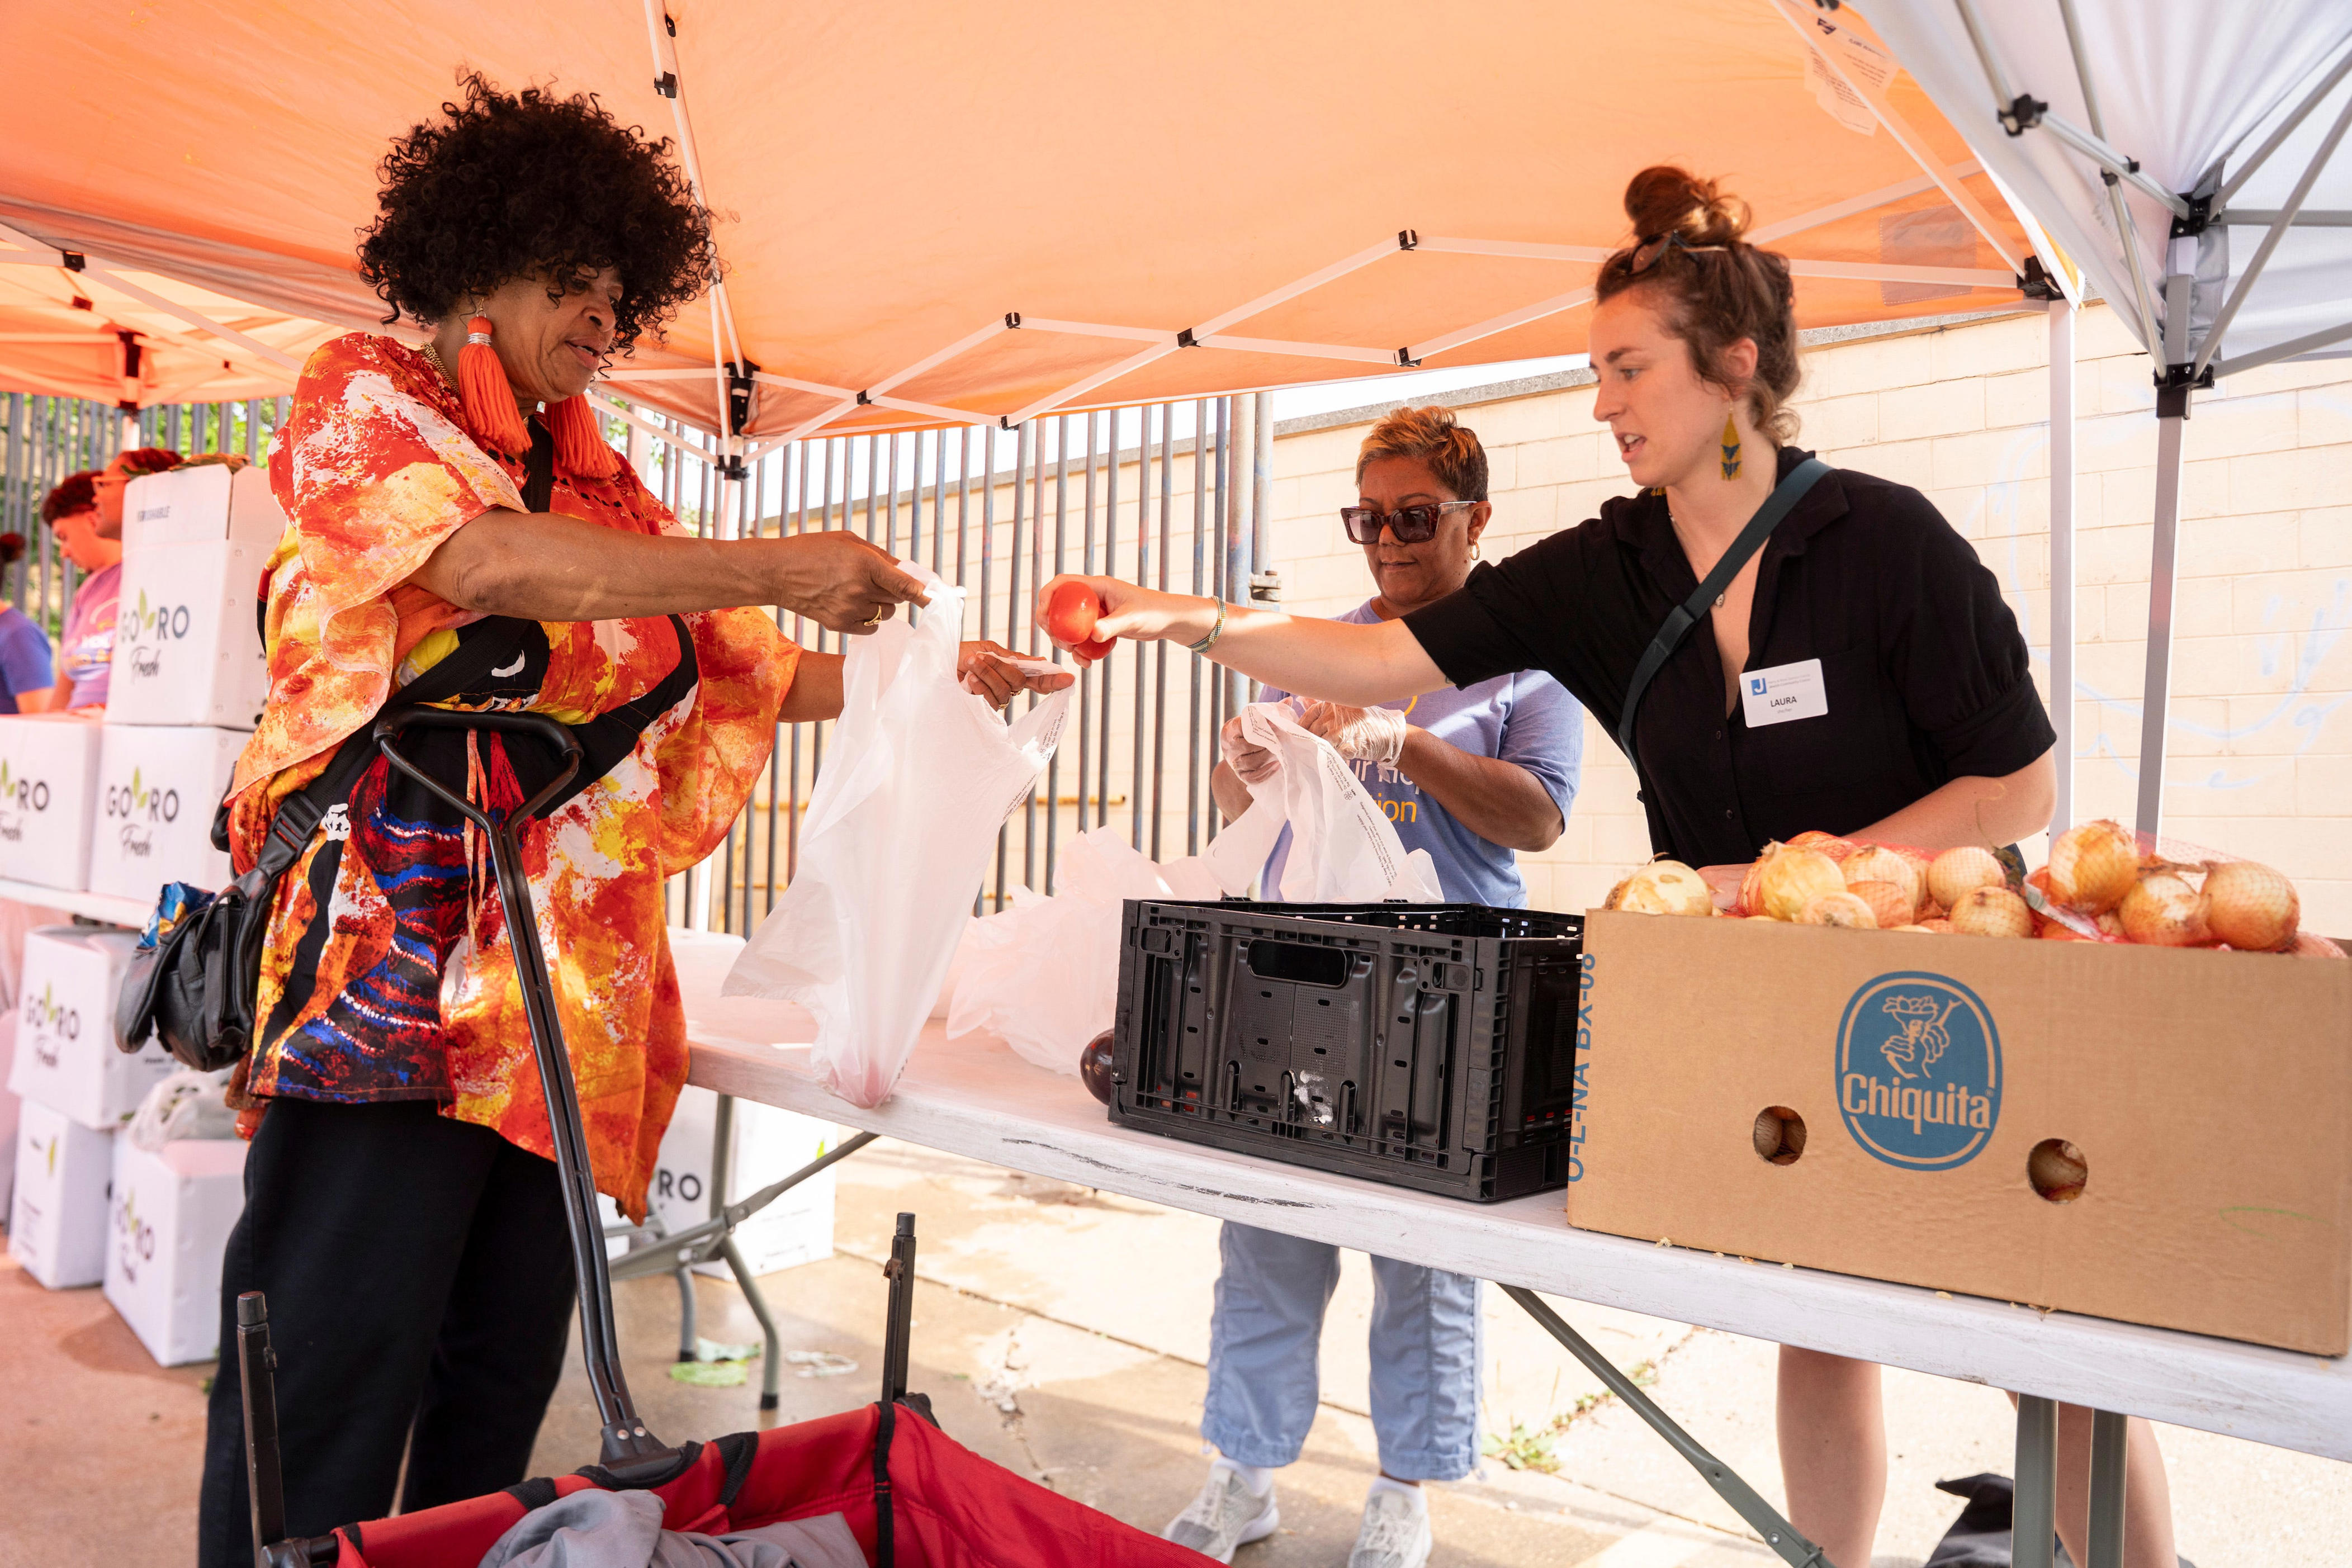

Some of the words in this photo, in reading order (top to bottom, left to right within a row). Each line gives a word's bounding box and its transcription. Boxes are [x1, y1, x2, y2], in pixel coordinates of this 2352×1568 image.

[1771, 695, 1797, 707] LAURA
[1843, 1073, 1991, 1134] Chiquita
[658, 1168, 702, 1202] RO
